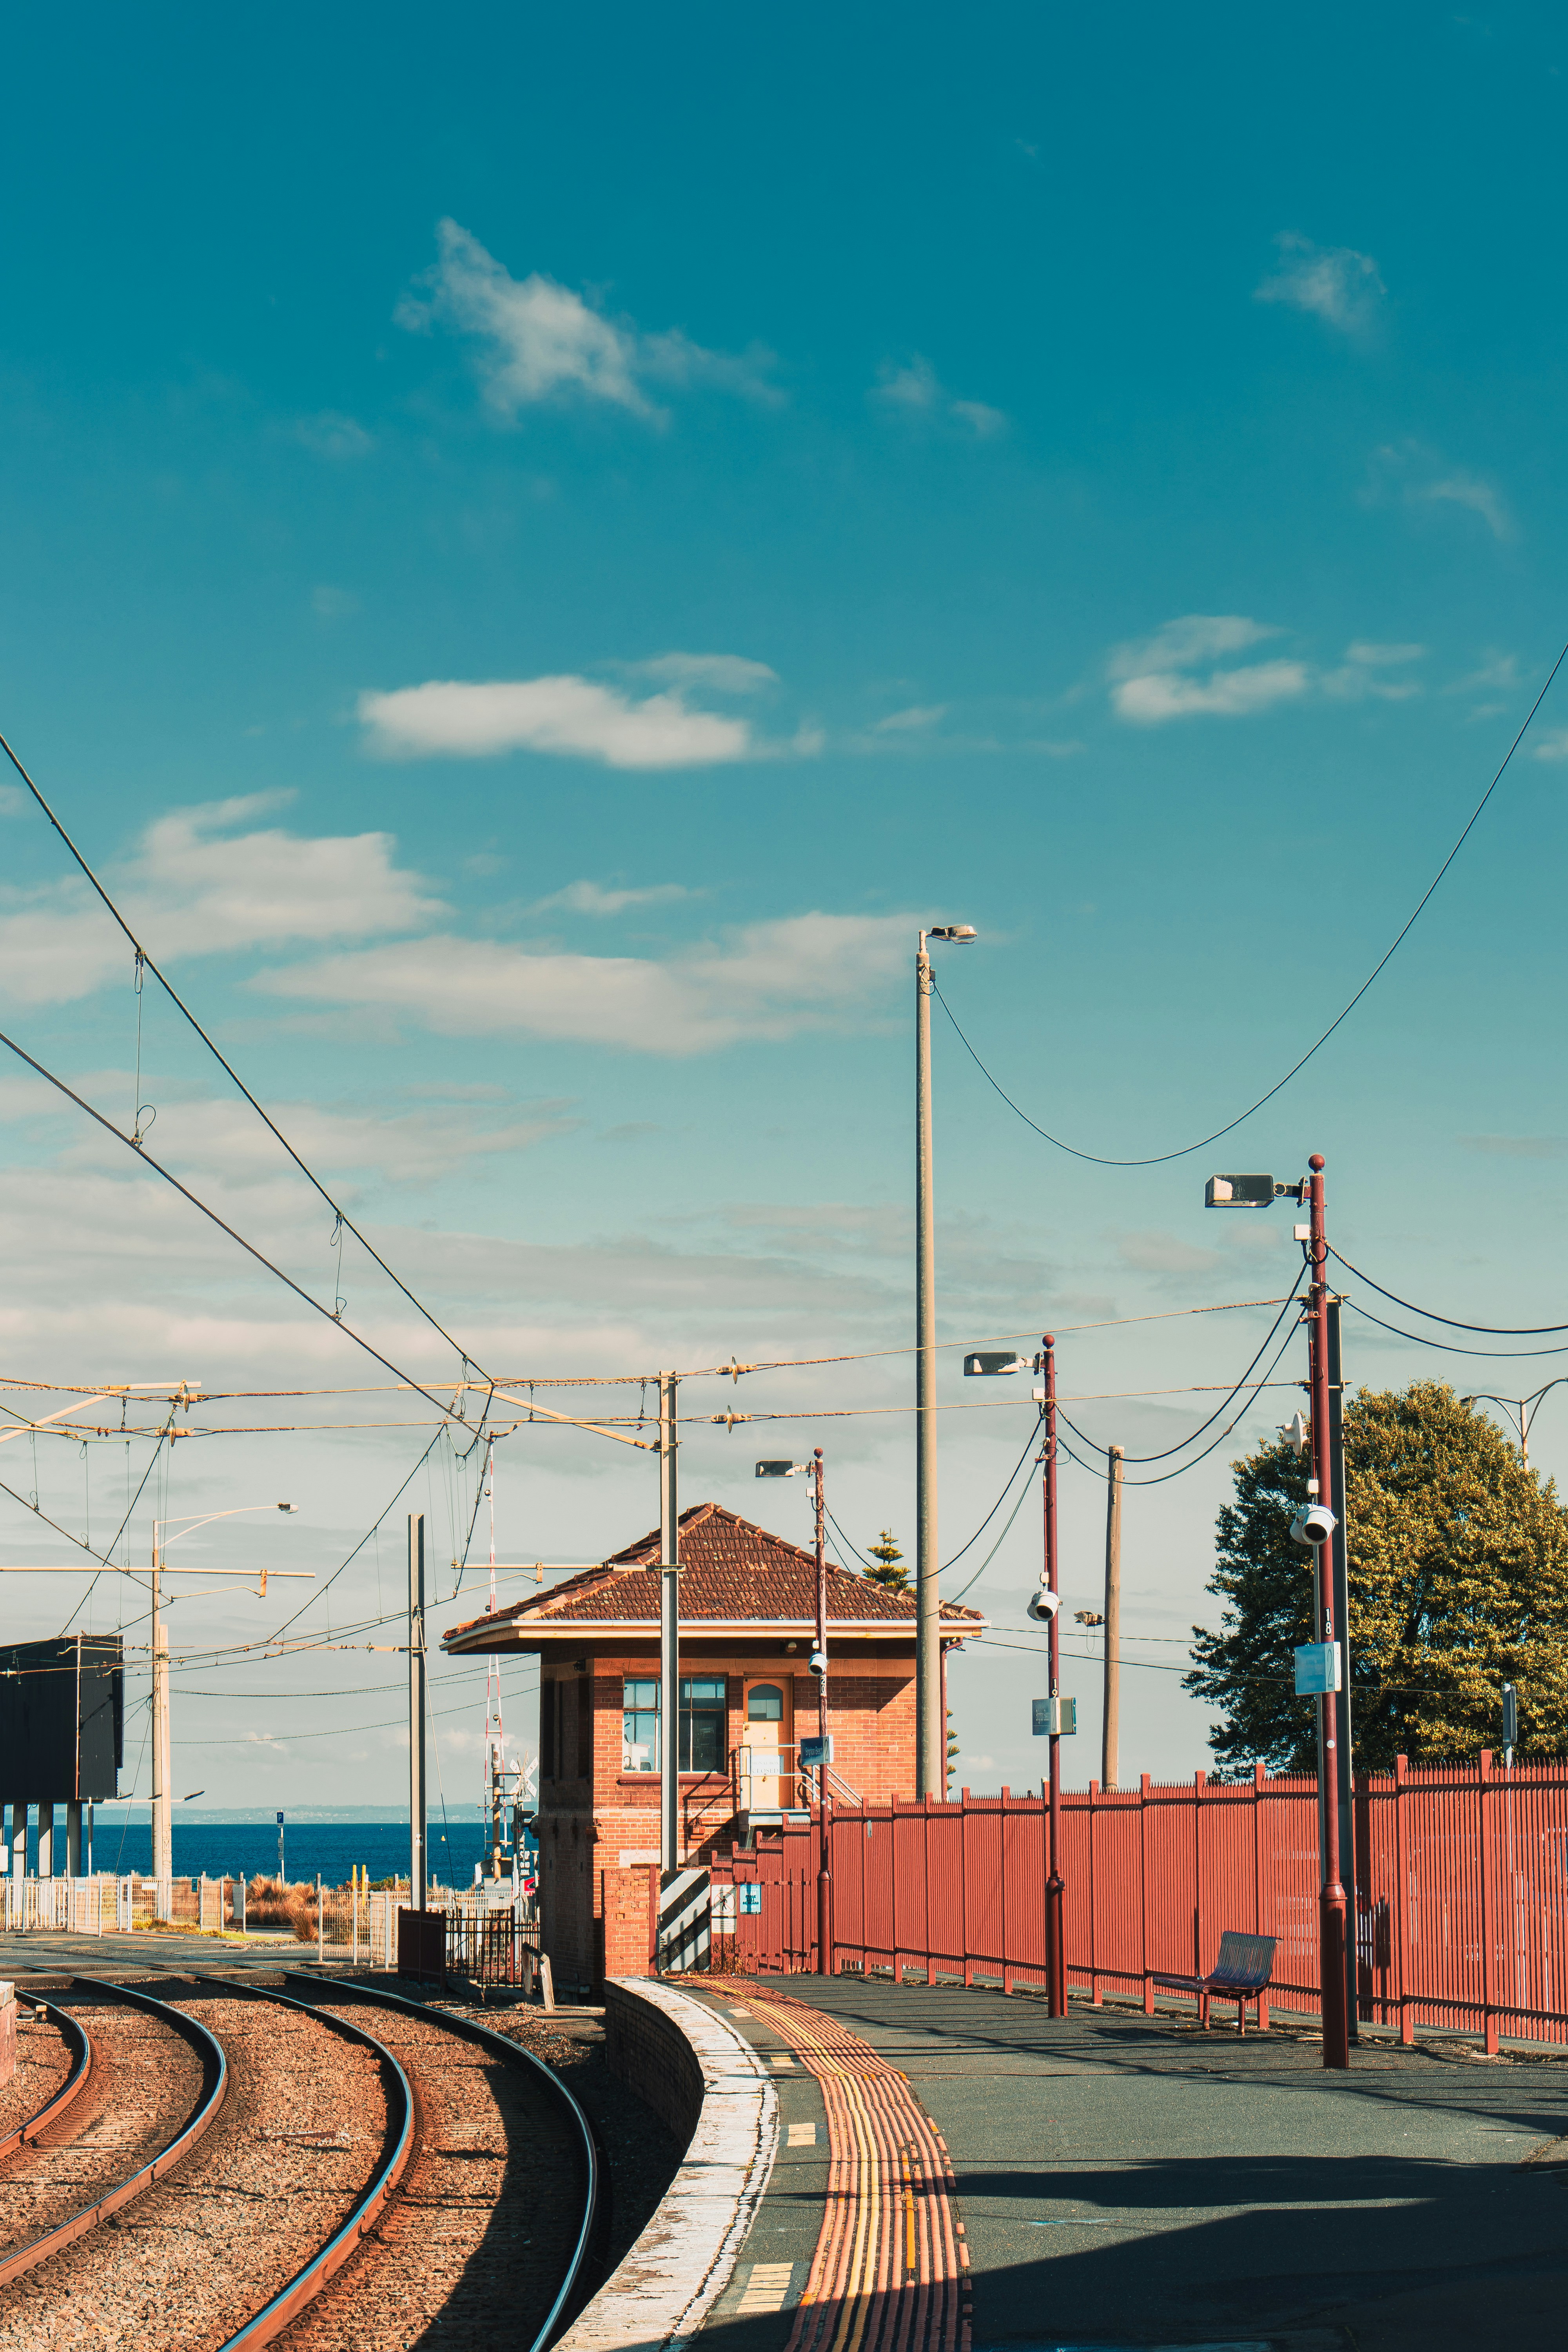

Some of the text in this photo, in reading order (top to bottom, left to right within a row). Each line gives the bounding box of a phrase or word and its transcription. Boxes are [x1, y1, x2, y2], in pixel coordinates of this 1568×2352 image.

[1326, 1608, 1332, 1635] 18
[1327, 1648, 1333, 1687] 2
[821, 1677, 825, 1693] 20
[1052, 1678, 1058, 1699] 19
[824, 1739, 828, 1761] 2
